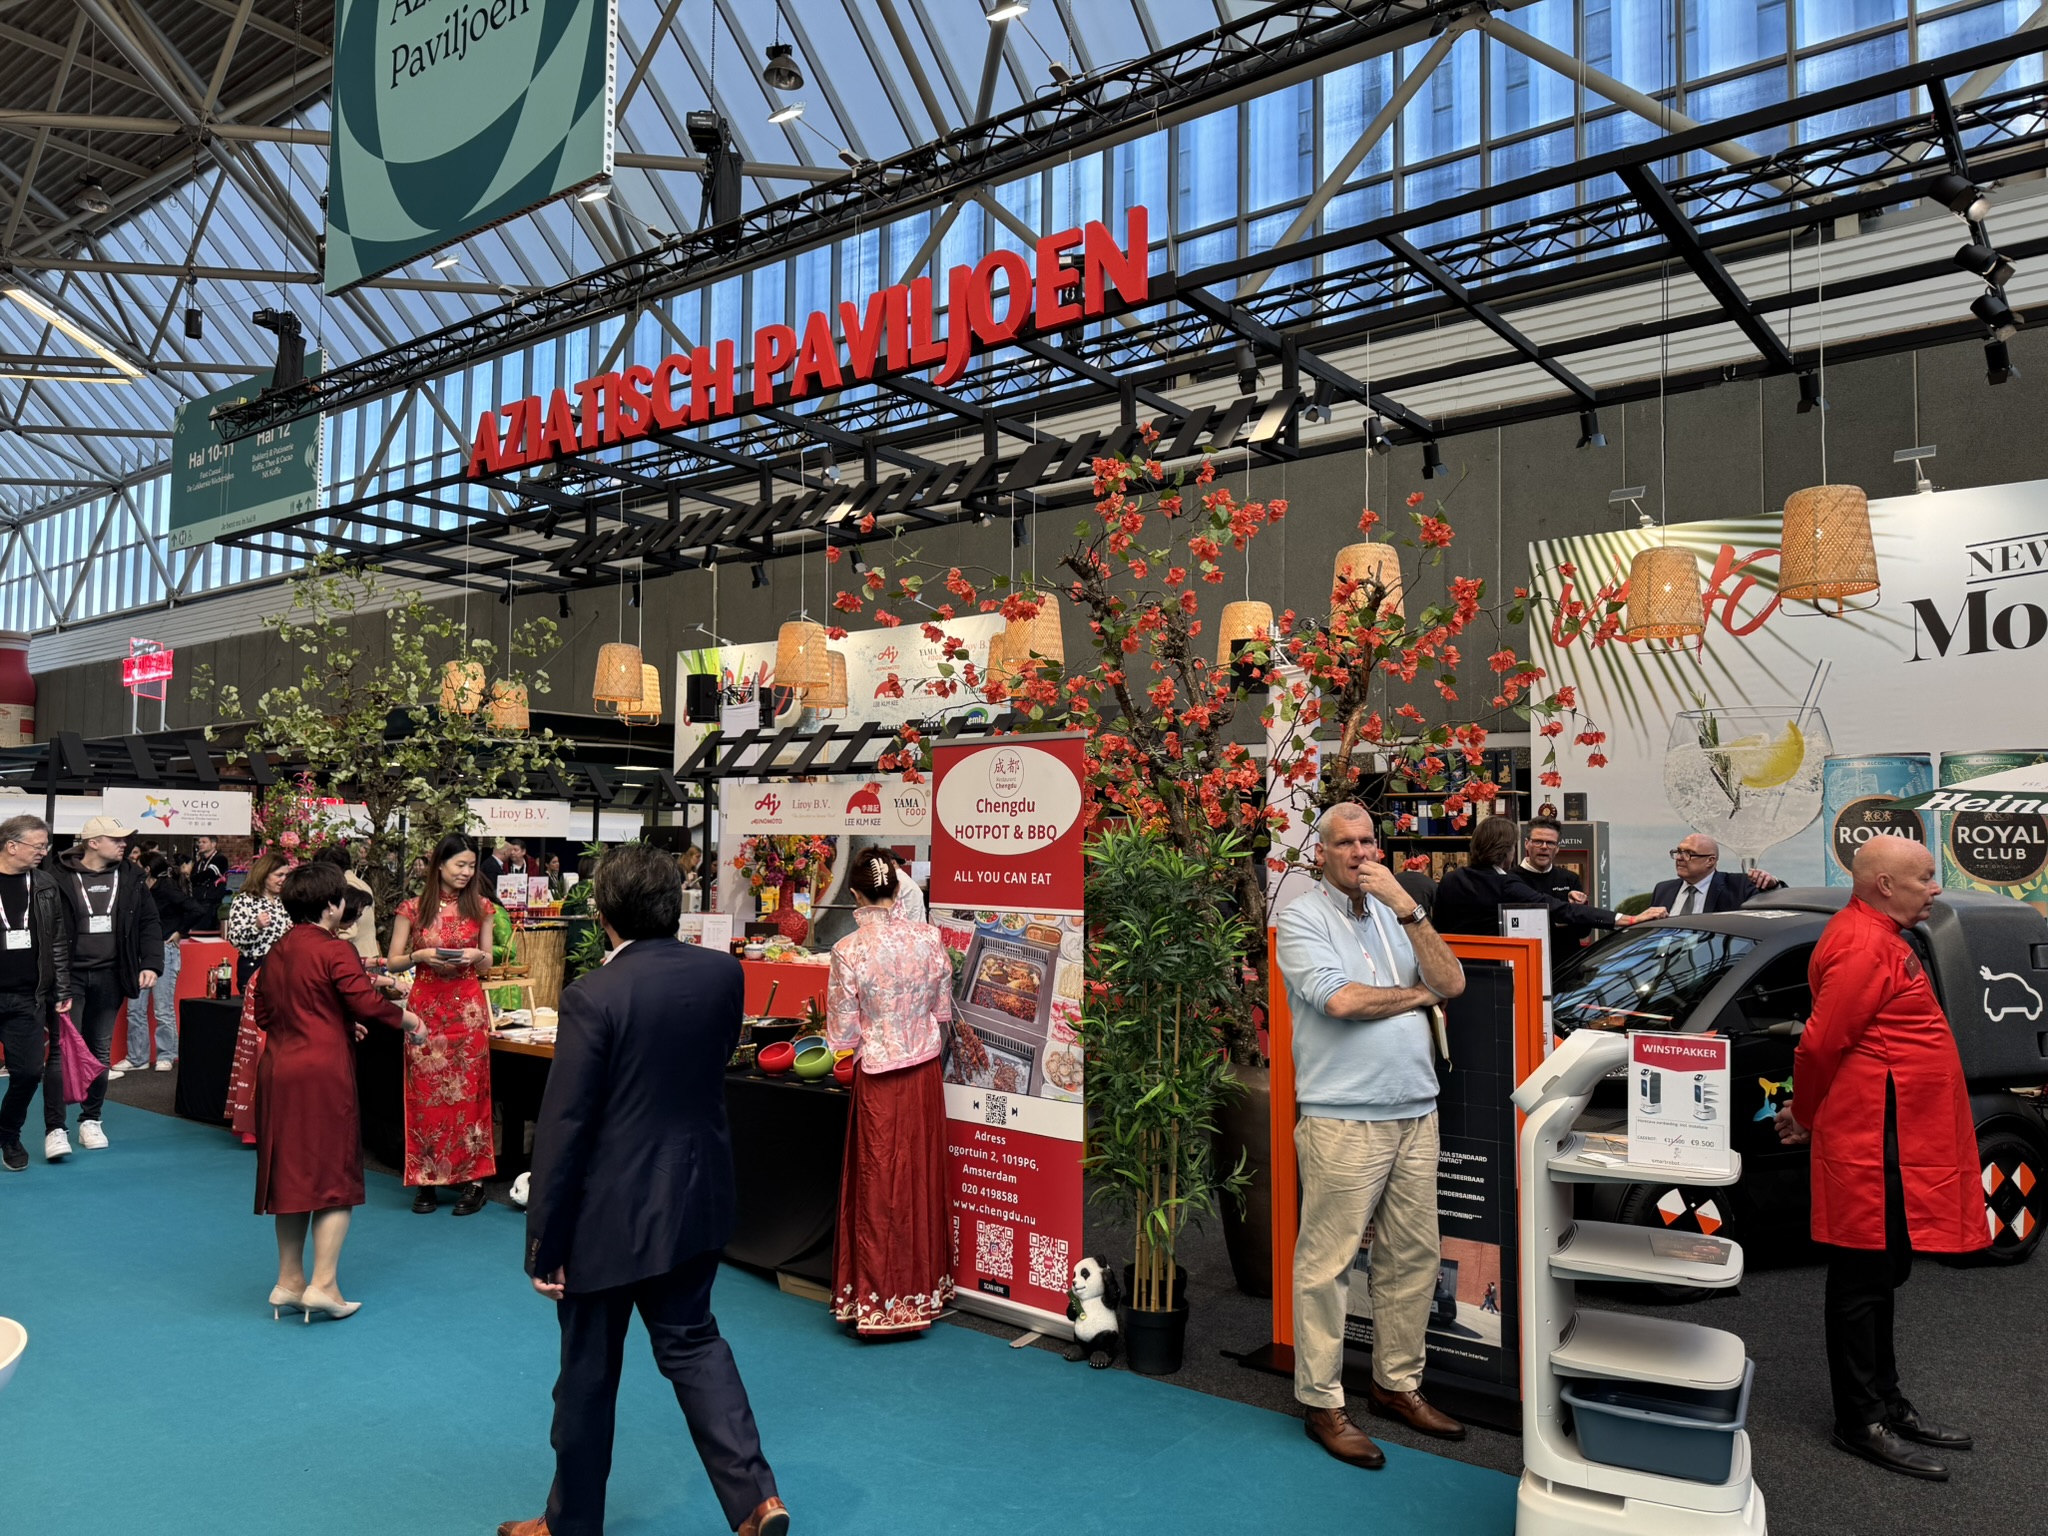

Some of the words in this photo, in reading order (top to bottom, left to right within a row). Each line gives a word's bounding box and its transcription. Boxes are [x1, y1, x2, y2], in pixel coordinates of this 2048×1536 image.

[466, 338, 735, 479] AZIATISCH
[753, 205, 1149, 405] PAVILJOEN
[256, 427, 274, 447] Hal
[277, 424, 291, 439] 12
[188, 448, 205, 470] Hal
[208, 443, 234, 463] 10-11
[995, 783, 1018, 791] Chengdu
[181, 800, 220, 809] VCHO
[754, 792, 782, 816] Aj
[792, 799, 812, 812] Liroy
[813, 799, 831, 809] B.V.
[893, 798, 919, 808] YAMA
[976, 797, 1036, 817] Chengdu
[1914, 791, 2048, 815] Hein
[490, 806, 521, 822] Liroy
[525, 808, 550, 820] B.V.
[905, 808, 927, 816] FOOD
[844, 818, 855, 826] LEE
[856, 818, 870, 826] KUM
[870, 817, 882, 826] KEE
[955, 824, 1010, 840] HOTPOT
[1013, 825, 1024, 840] &
[1027, 824, 1058, 842] BBQ
[1957, 825, 2046, 844] ROYAL
[1973, 848, 2027, 860] CLUB
[954, 870, 974, 883] ALL
[977, 871, 1001, 884] YOU
[1003, 872, 1027, 885] CAN
[1031, 872, 1052, 886] EAT
[1641, 1043, 1718, 1059] WINSTPAKKER
[974, 1129, 1007, 1145] Adress
[948, 1144, 989, 1160] ogortuin
[989, 1151, 999, 1164] 2,
[1002, 1154, 1040, 1172] 1019PG,
[1439, 1156, 1463, 1165] ONTACT
[1451, 1152, 1488, 1163] STANDAARD
[962, 1163, 1018, 1184] Amsterdam
[1436, 1171, 1485, 1184] ONALISEERBAAR
[961, 1182, 978, 1196] 020
[980, 1186, 1019, 1204] 4198588
[952, 1199, 1037, 1226] www.chengdu.nu
[983, 1282, 994, 1293] SCAN
[994, 1284, 1005, 1295] HERE
